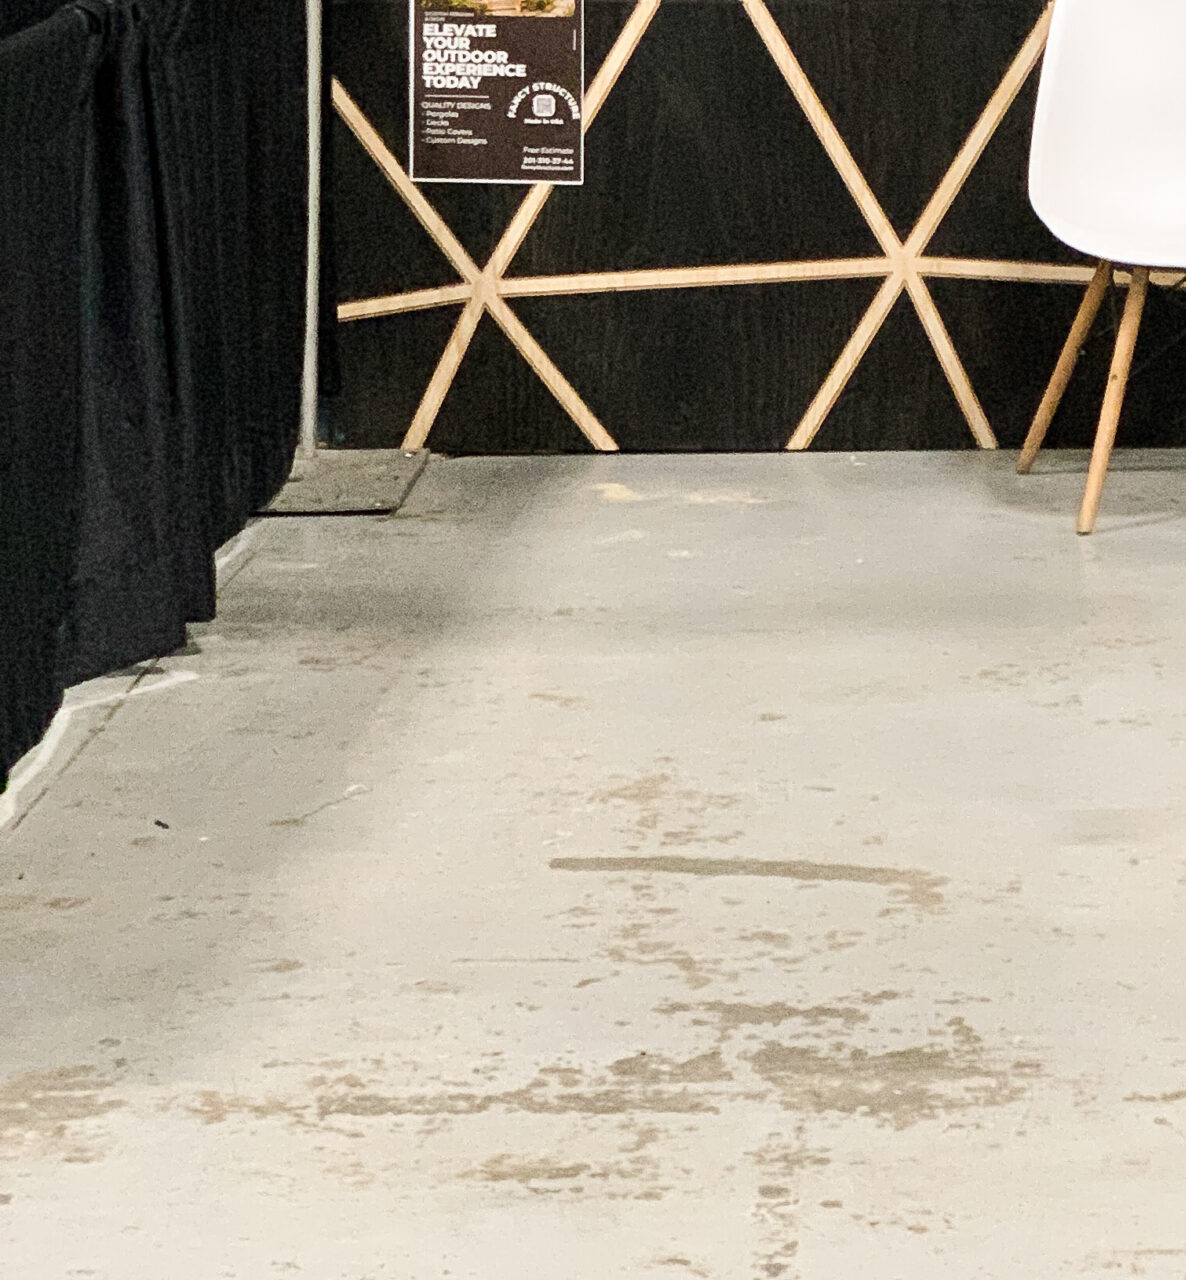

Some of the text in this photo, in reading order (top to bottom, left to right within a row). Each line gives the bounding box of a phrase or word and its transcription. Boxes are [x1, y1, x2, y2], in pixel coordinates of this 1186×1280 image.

[423, 23, 497, 37] ELEVATE
[423, 37, 470, 49] YOUR
[422, 50, 508, 63] OUTDOOR
[423, 63, 527, 77] EXPERIENCE
[422, 76, 482, 89] TODAY
[506, 82, 580, 119] FANCY STRUCTURE
